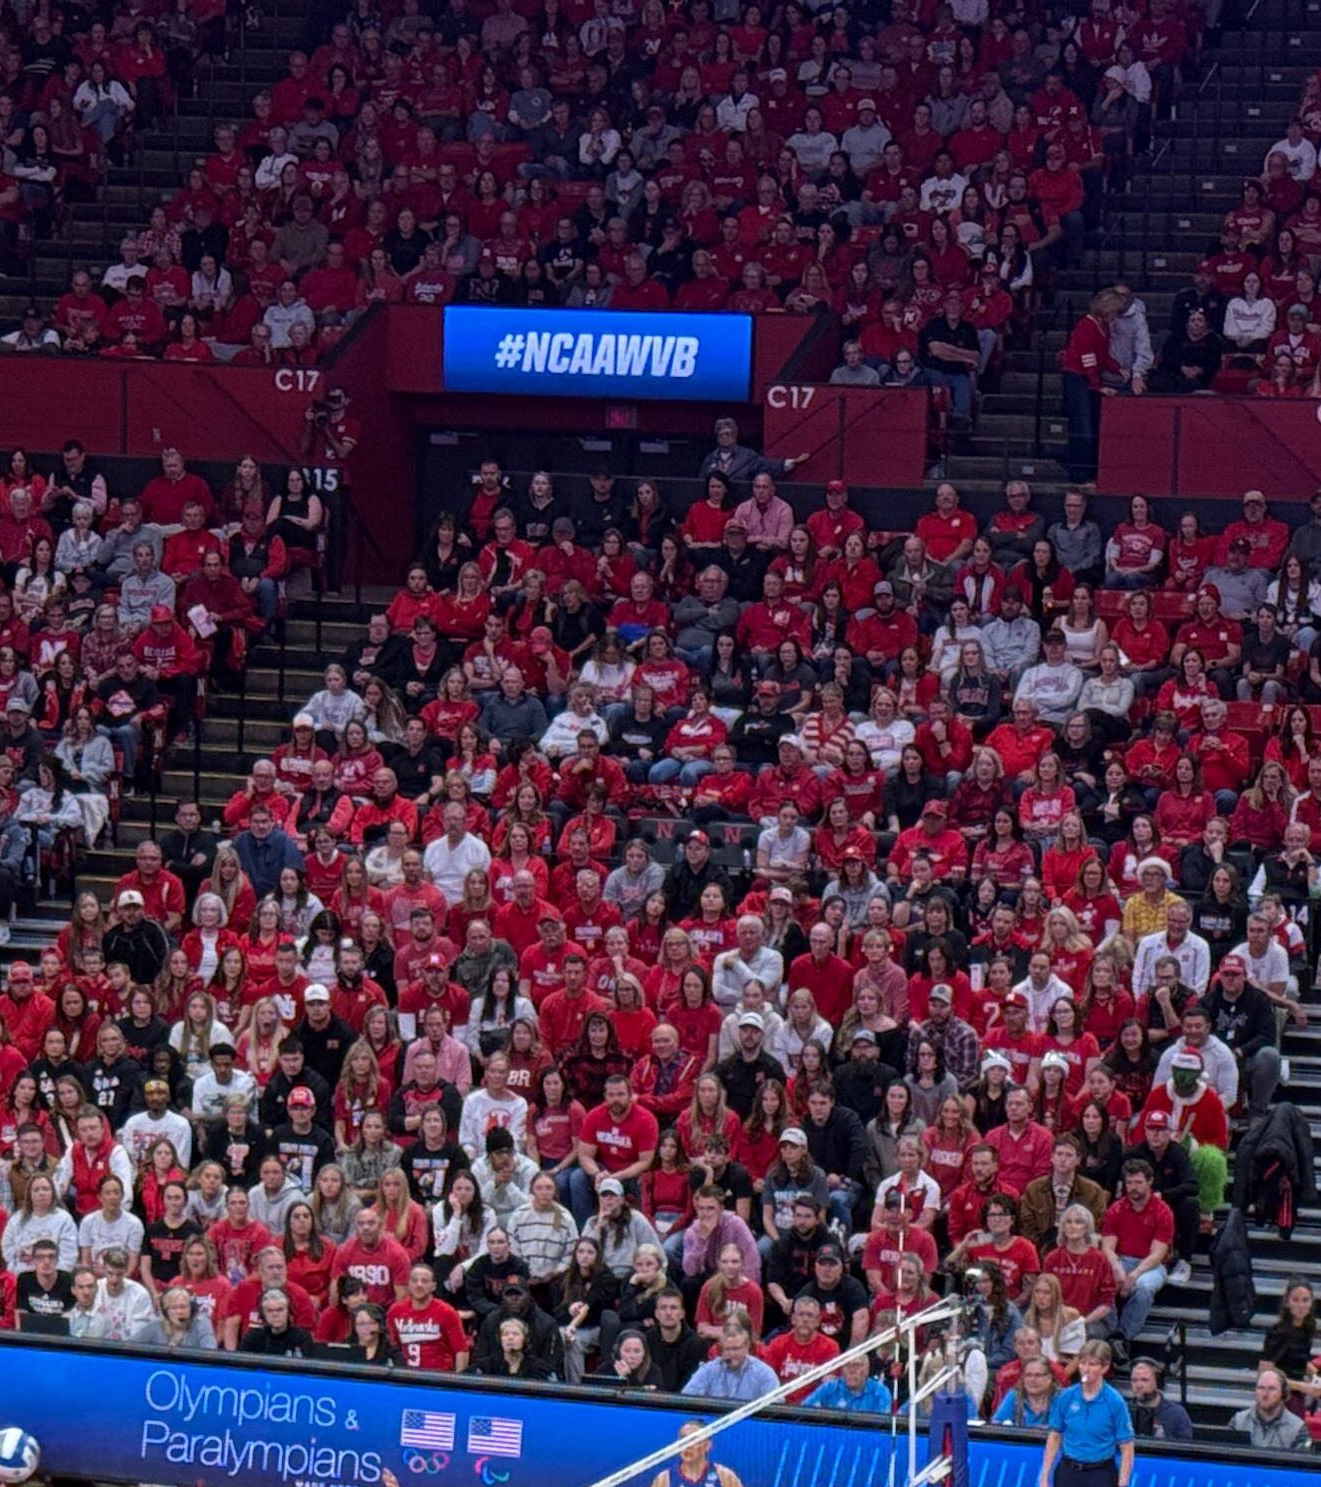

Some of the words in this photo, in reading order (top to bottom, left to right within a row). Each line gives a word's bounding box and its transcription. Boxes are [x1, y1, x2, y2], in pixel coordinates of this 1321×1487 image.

[495, 331, 699, 378] #NCAAWVB
[275, 368, 320, 393] C17
[767, 385, 815, 409] C17
[394, 1317, 441, 1334] Nebraska
[145, 1370, 337, 1428] Olympians
[344, 1409, 360, 1430] &
[141, 1420, 381, 1483] Paralympians
